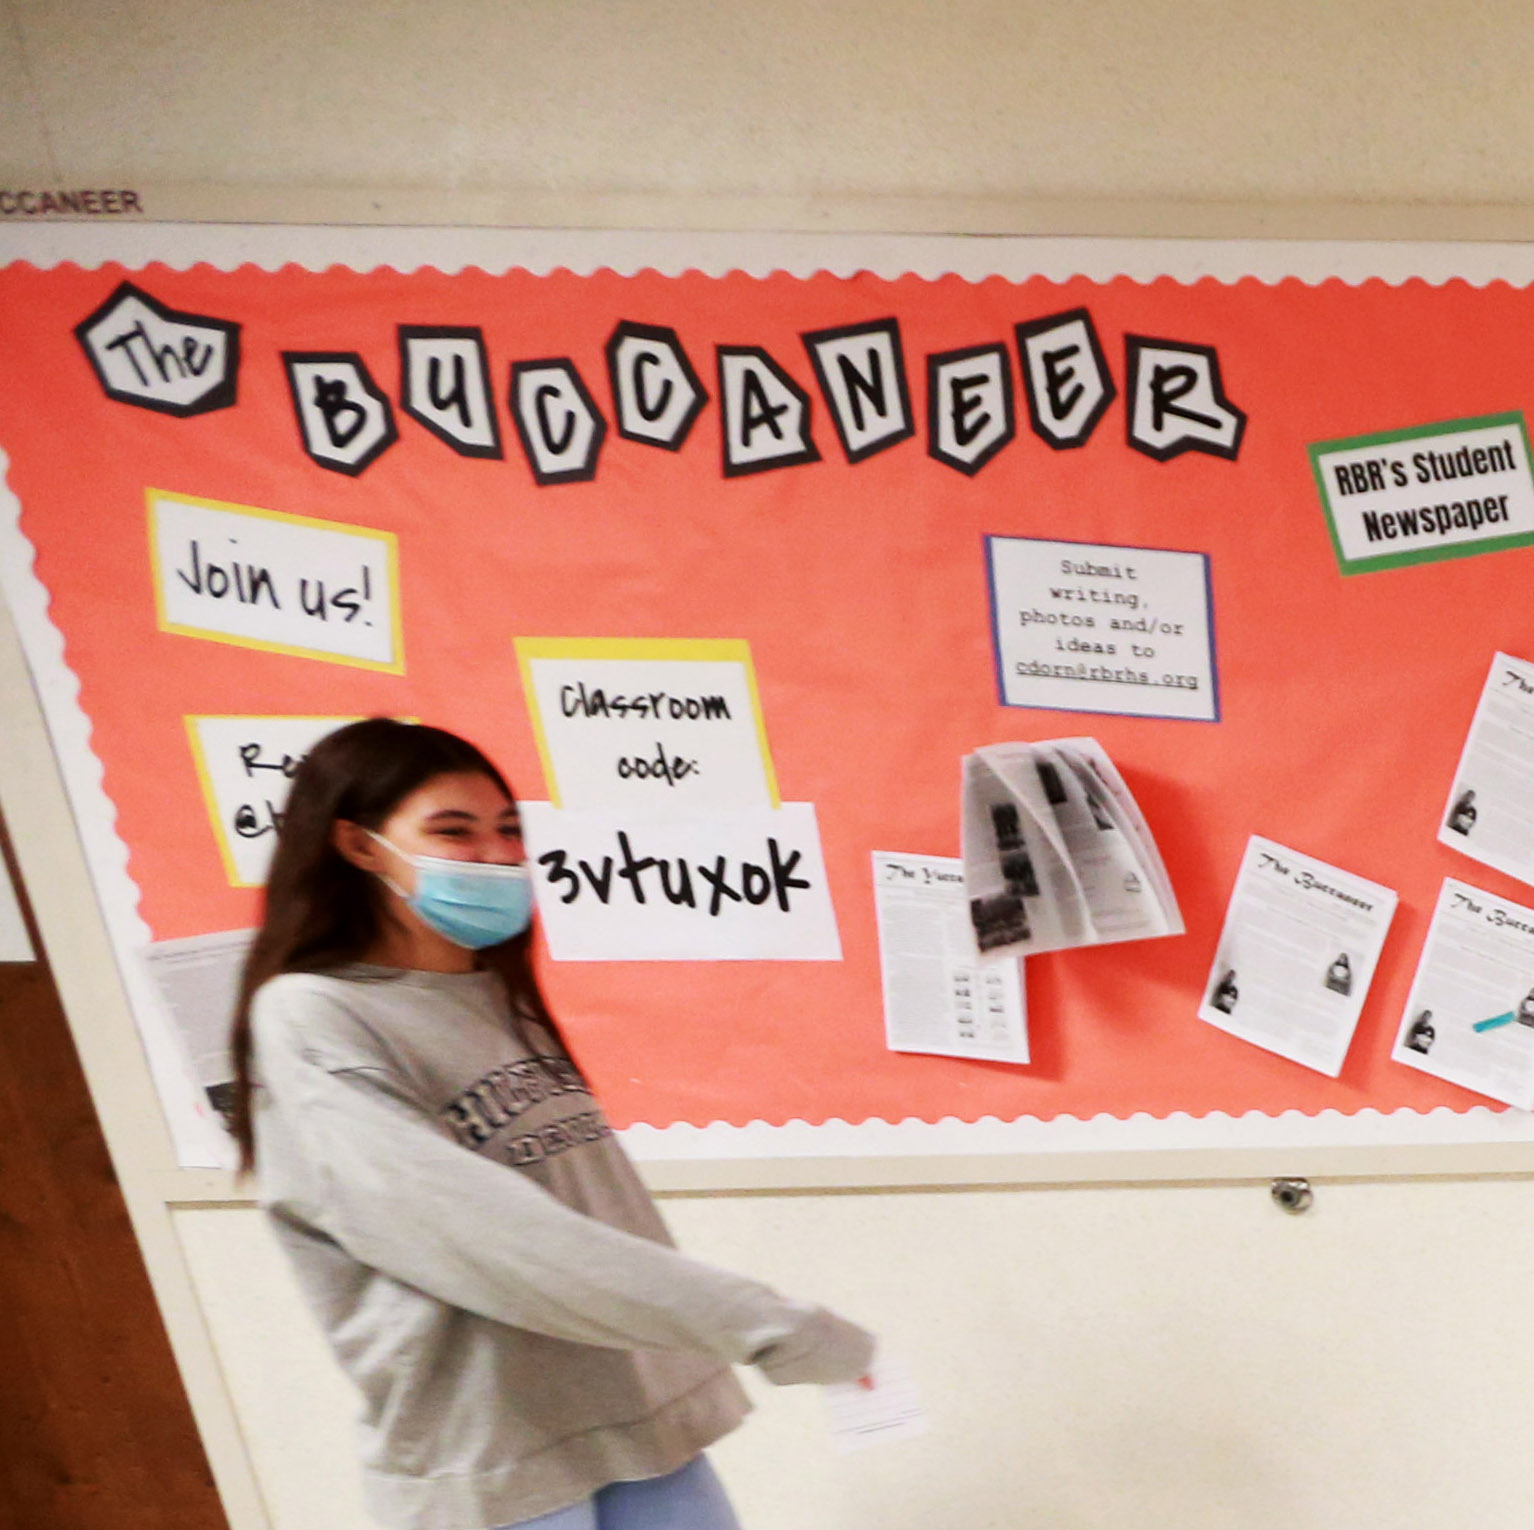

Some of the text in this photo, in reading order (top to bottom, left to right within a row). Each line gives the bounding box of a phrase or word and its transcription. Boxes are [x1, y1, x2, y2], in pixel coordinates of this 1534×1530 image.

[106, 320, 1224, 456] The BUCCANEER
[1334, 439, 1517, 496] RBR's Student
[1362, 495, 1510, 543] Newspaper
[176, 538, 374, 627] Join us!
[1060, 559, 1138, 580] Submit
[1018, 609, 1185, 636] photos and/or
[1055, 637, 1155, 659] ideas to
[560, 681, 733, 720] Classroom
[1502, 671, 1534, 695] The
